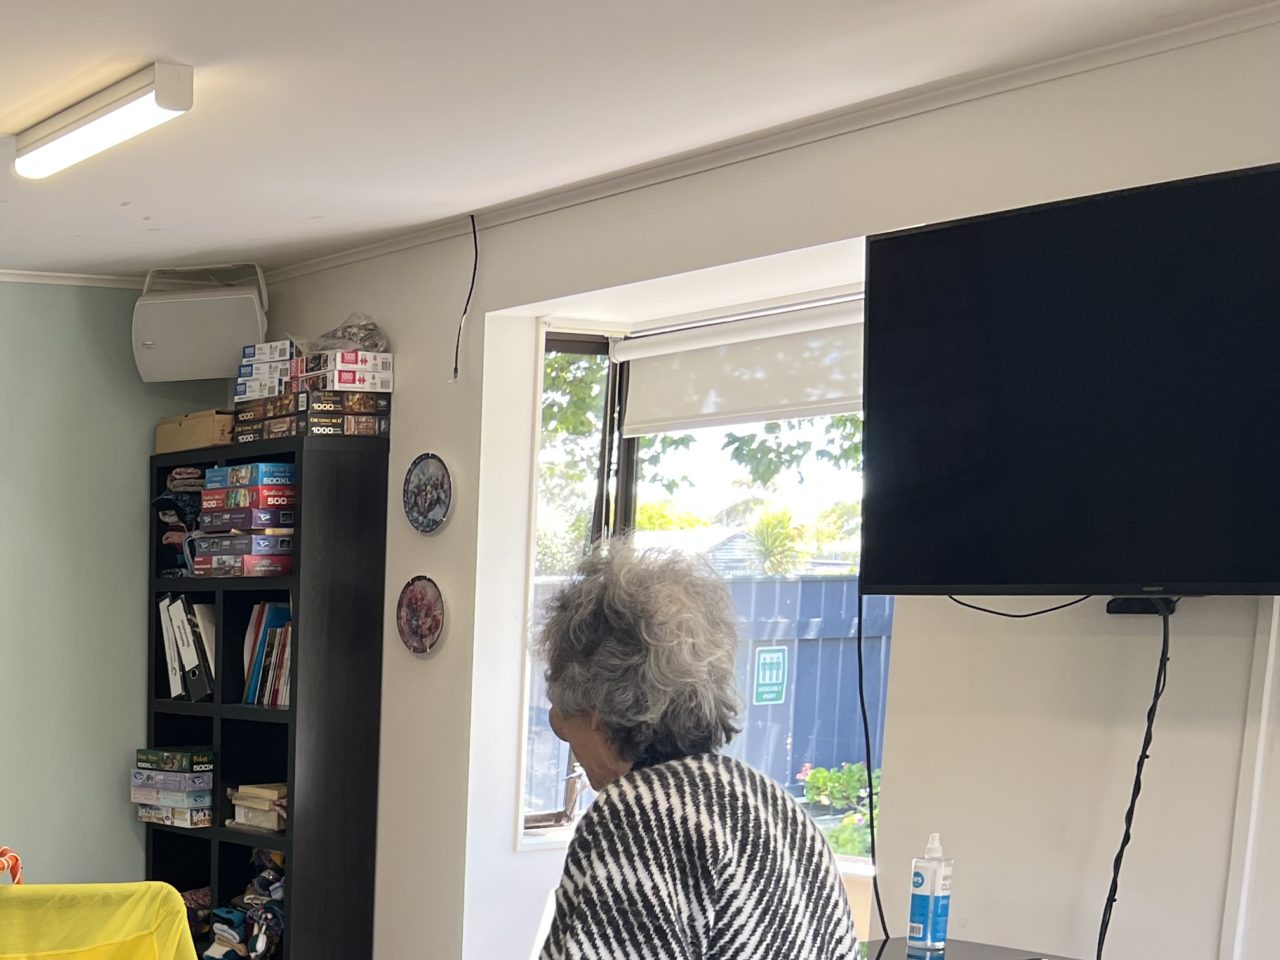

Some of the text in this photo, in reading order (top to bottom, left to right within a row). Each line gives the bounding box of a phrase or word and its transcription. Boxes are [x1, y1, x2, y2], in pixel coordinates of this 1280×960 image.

[312, 403, 334, 411] 1000
[238, 411, 254, 421] 1000
[311, 426, 334, 435] 1000
[238, 433, 254, 443] 1000
[202, 500, 217, 509] 500
[267, 497, 287, 505] 500
